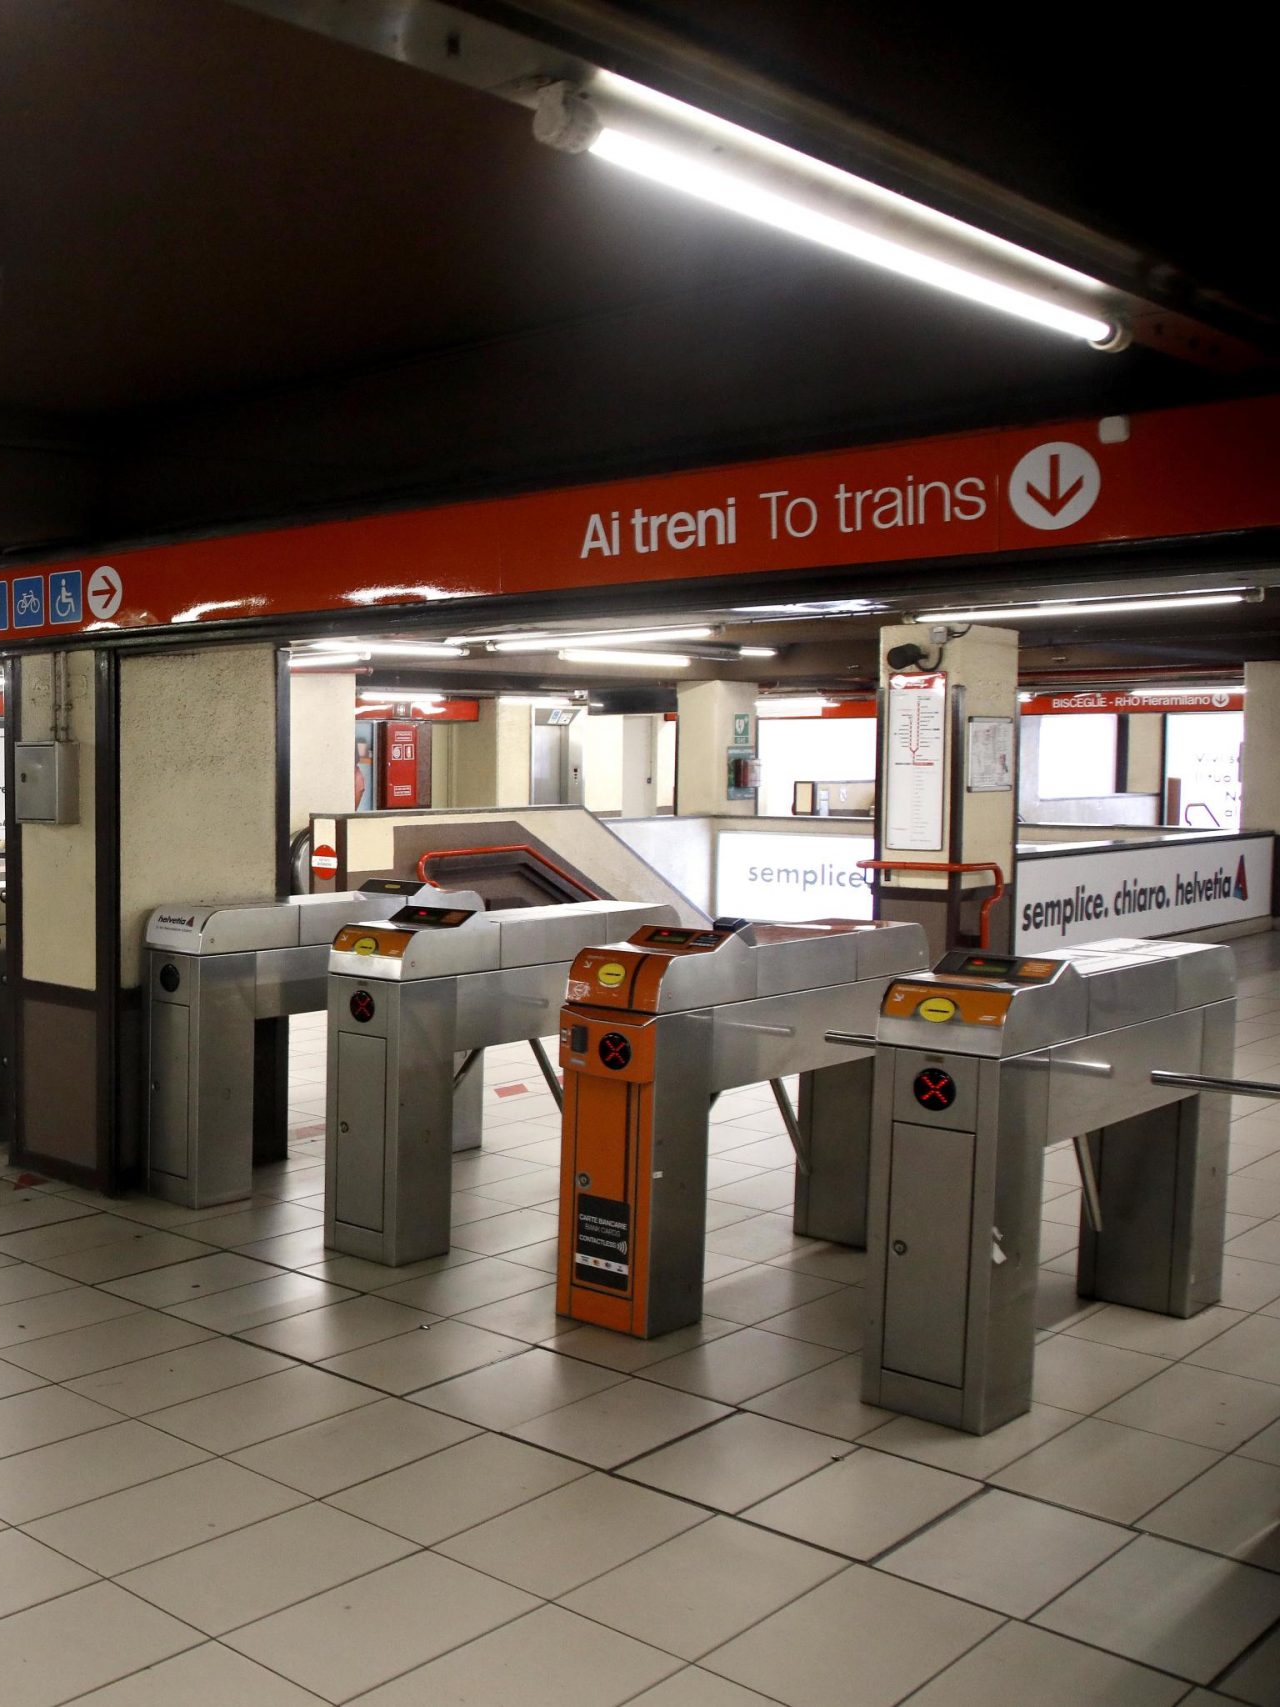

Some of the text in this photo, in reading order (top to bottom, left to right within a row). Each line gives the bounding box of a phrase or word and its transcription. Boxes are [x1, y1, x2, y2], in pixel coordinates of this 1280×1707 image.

[581, 474, 986, 559] Ai treni To trains
[1052, 697, 1107, 708] BISCEGLIE
[1115, 697, 1140, 707] RHO
[1142, 694, 1210, 706] Fieramilano
[158, 914, 186, 924] helvetia
[1022, 867, 1232, 936] semplice. chiaro. helvetia
